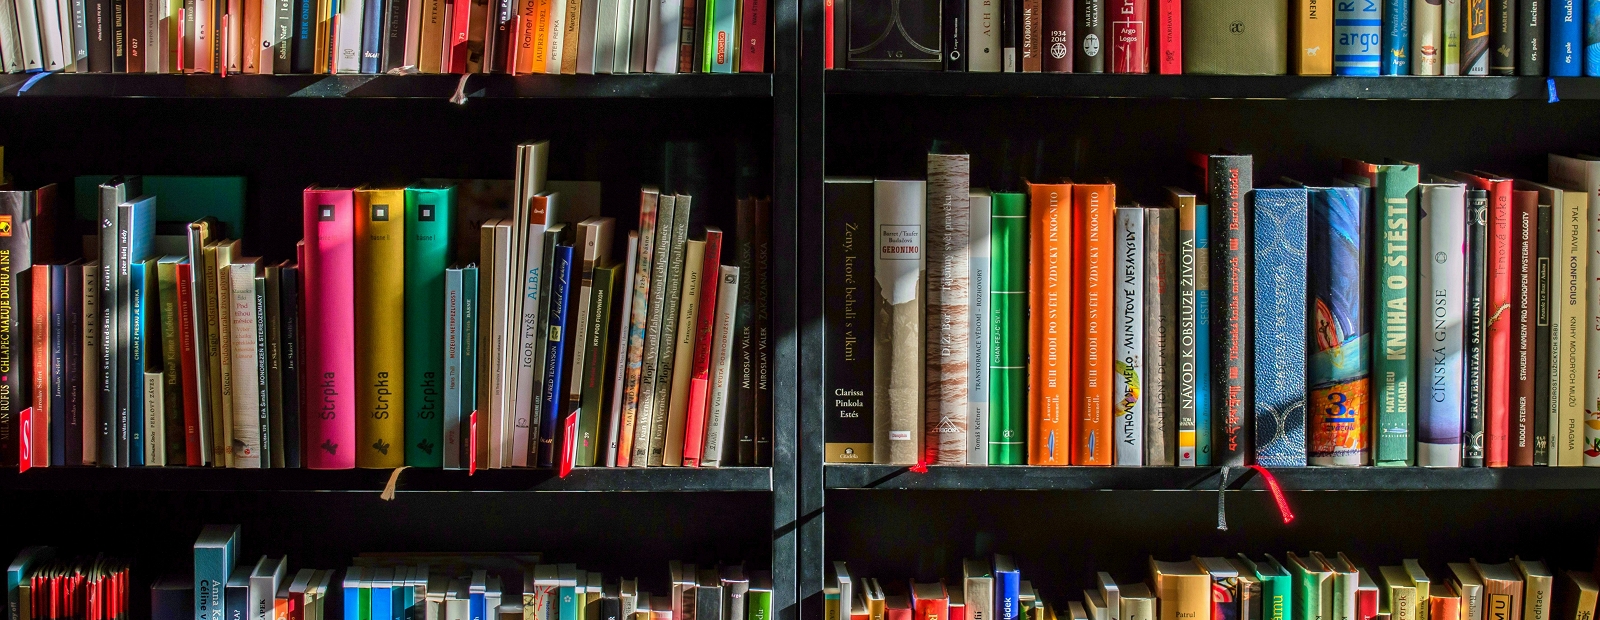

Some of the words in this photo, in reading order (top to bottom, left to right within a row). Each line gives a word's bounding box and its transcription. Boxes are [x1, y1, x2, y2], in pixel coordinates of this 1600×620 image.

[391, 6, 399, 38] Richard
[523, 19, 532, 48] Rainer
[1024, 49, 1030, 58] M.
[1339, 33, 1379, 52] argo
[1049, 192, 1058, 242] INKOGNITO
[1090, 192, 1099, 242] INKOGNITO
[1229, 202, 1239, 230] Bardo
[1494, 196, 1507, 229] dívka
[1571, 206, 1579, 223] TAK
[845, 222, 858, 252] Ženy,
[1383, 197, 1408, 267] ŠTĚSTÍ
[1570, 225, 1579, 254] PRAVIL
[741, 242, 751, 269] LÁSKA
[758, 242, 768, 270] LÁSKA
[1047, 245, 1058, 288] VŽDYCKY
[1088, 245, 1099, 288] VŽDYCKY
[1124, 229, 1136, 285] NESMYSLY
[1180, 238, 1193, 286] ŽIVOTA
[1494, 234, 1506, 278] Trnová
[528, 267, 539, 300] ALBA
[844, 256, 856, 286] ktoré
[1228, 257, 1240, 293] mrtvých
[1387, 275, 1408, 289] O
[1569, 256, 1578, 305] KONFUCIUS
[844, 288, 856, 319] behali
[1047, 291, 1058, 318] SVĚTĚ
[1088, 291, 1099, 318] SVĚTĚ
[1519, 274, 1529, 308] POCHOPENÍ
[684, 321, 692, 344] François
[688, 270, 697, 295] BALADY
[1124, 289, 1135, 348] MINUTOVÉ
[1182, 288, 1193, 346] OBSLUZE
[1200, 291, 1210, 325] SESTUP
[1229, 295, 1239, 321] kniha
[1435, 289, 1447, 341] GNOSE
[1471, 297, 1480, 344] SATURNI
[1520, 310, 1528, 322] PRO
[525, 313, 535, 337] TYŠŠ
[741, 326, 751, 348] VÁLEK
[758, 327, 767, 349] VÁLEK
[974, 314, 982, 339] VĚDOMÍ
[1048, 321, 1058, 334] PO
[1089, 321, 1098, 334] PO
[1386, 299, 1407, 360] KNIHA
[1568, 316, 1576, 339] KNIHY
[524, 343, 533, 367] IGOR
[844, 331, 853, 361] vlkmi
[1046, 337, 1058, 366] CHODÍ
[1087, 337, 1098, 366] CHODÍ
[1158, 325, 1166, 358] MELLO
[1182, 348, 1193, 358] K
[1229, 323, 1239, 360] Tibetská
[548, 346, 557, 377] TENNYSON
[742, 351, 751, 389] MIROSLAV
[758, 351, 767, 390] MIROSLAV
[1124, 357, 1135, 385] MELLO
[1158, 360, 1166, 374] DE
[1431, 346, 1446, 402] ČÍNSKÁ
[1519, 351, 1527, 380] STAVEBNÍ
[1568, 341, 1576, 383] MOUDRÝCH
[1046, 370, 1058, 388] BŮH
[1087, 370, 1098, 388] BŮH
[1125, 386, 1134, 396] DE
[1181, 361, 1193, 409] NÁVOD
[1385, 372, 1395, 412] MATTHIEU
[1470, 347, 1480, 419] FRATERNITAS
[318, 372, 338, 420] Štrpka
[371, 372, 392, 420] Štrpka
[416, 372, 438, 420] Štrpka
[835, 399, 863, 407] Pinkola
[1044, 396, 1052, 421] Laurent
[1158, 376, 1167, 432] ANTHONY
[1326, 392, 1355, 416] 3.
[1397, 382, 1407, 413] RICARD
[1568, 386, 1576, 408] MUŽŮ
[840, 410, 859, 418] Estés
[1124, 398, 1135, 445] ANTHONY
